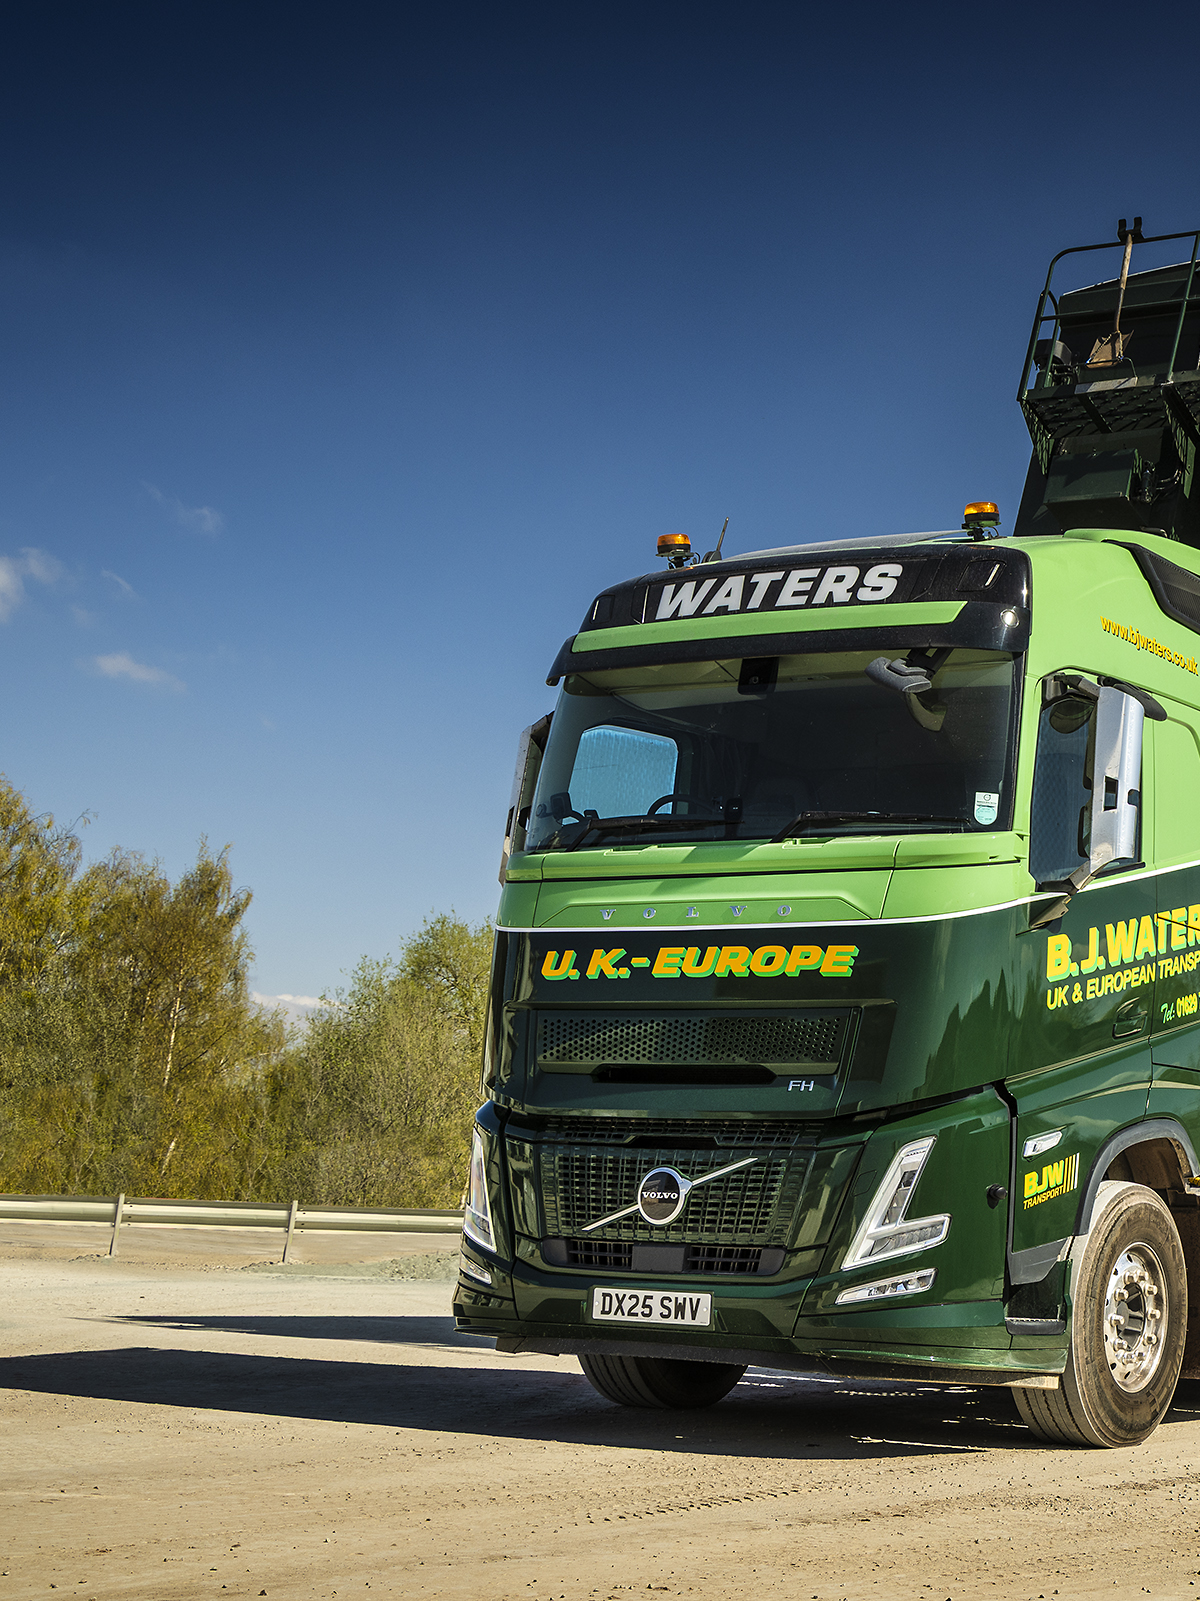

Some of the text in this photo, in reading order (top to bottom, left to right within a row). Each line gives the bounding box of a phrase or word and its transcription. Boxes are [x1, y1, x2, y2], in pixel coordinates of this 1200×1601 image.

[654, 563, 903, 621] WATERS
[1100, 615, 1199, 676] www.bjwaters.co.uk
[600, 904, 792, 920] VOLVO
[1046, 984, 1069, 1011] UK
[1071, 982, 1083, 1004] &
[1086, 962, 1156, 1001] EUROPEAN
[787, 1080, 815, 1092] FH
[1024, 1159, 1064, 1199] BJW
[641, 1191, 678, 1200] VOLVO
[1023, 1185, 1064, 1210] TRANSPORT
[600, 1291, 702, 1322] DX25 SWV
